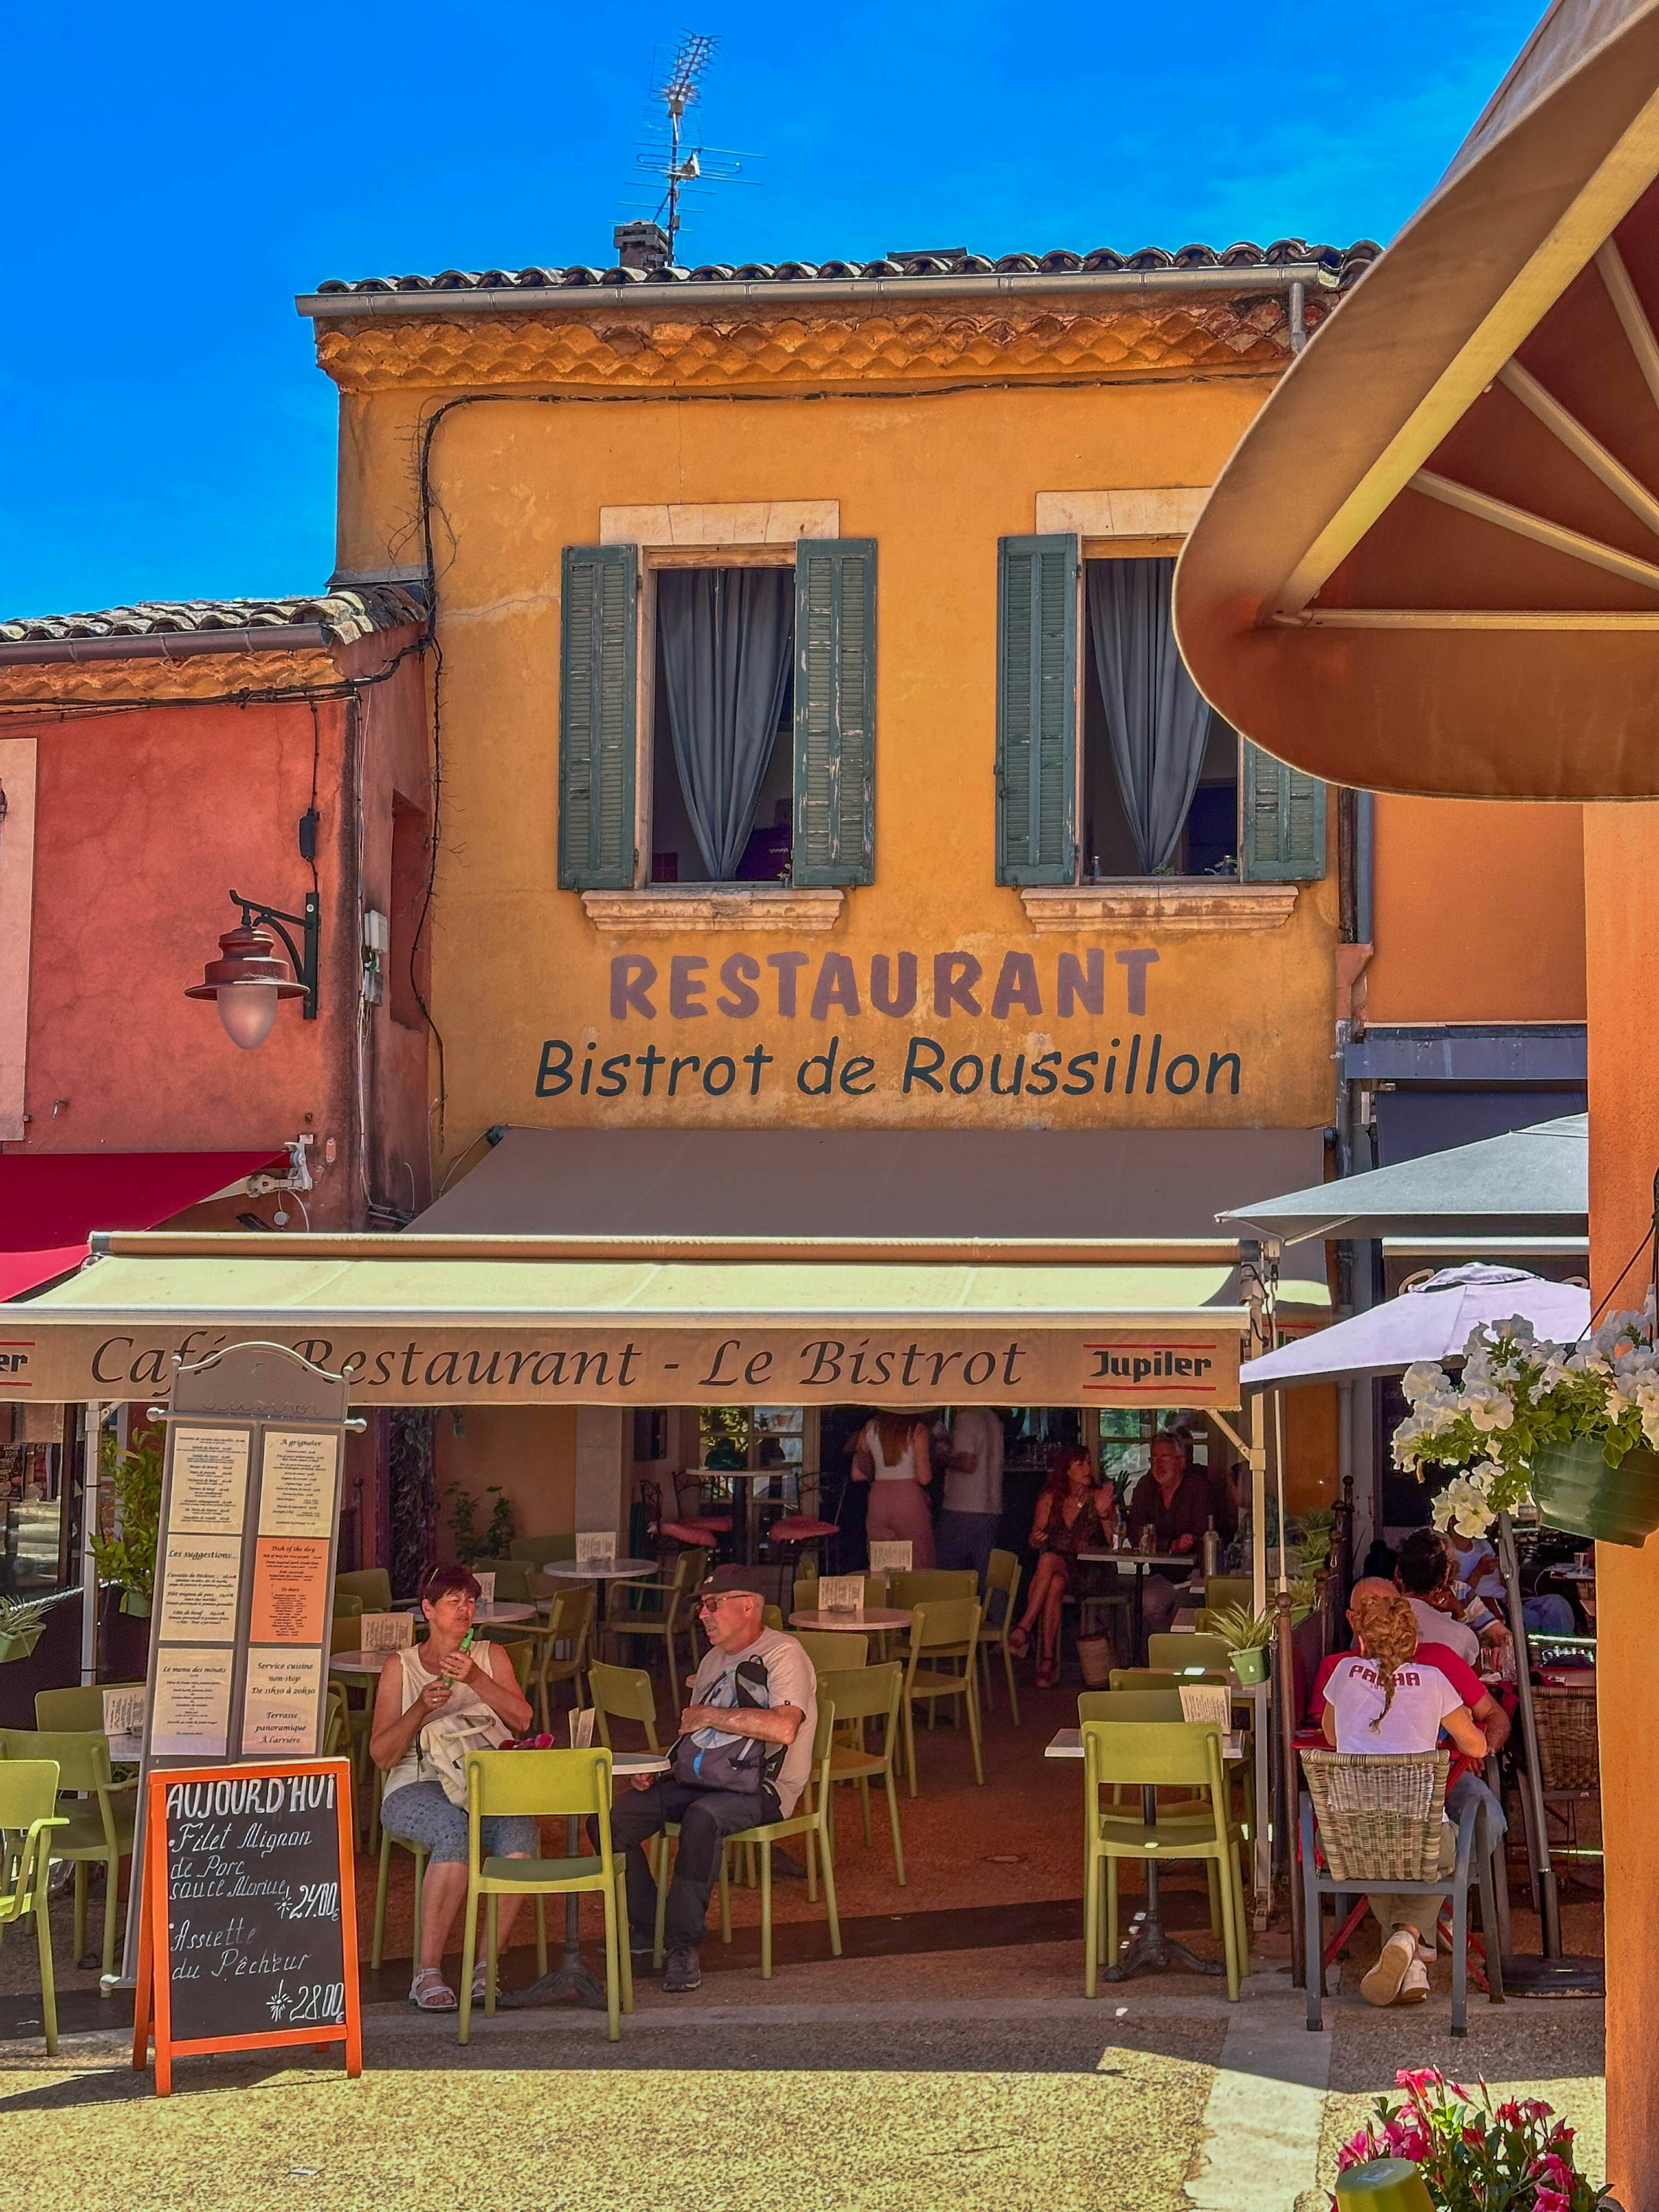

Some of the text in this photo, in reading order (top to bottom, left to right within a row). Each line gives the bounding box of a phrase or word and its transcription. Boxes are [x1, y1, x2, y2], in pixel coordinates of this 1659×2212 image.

[609, 948, 1160, 1021] RESTAURANT
[535, 1034, 1242, 1098] Bistrot de Roussillon
[291, 1338, 642, 1387] Restaurant
[697, 1340, 773, 1385] Le
[799, 1338, 1026, 1385] Bistrot
[1090, 1351, 1211, 1383] Jupiler
[254, 1724, 307, 1733] panoramique
[171, 1822, 232, 1853] Filet
[171, 1856, 245, 1880] de Porc
[170, 1879, 225, 1900] sauce
[171, 1917, 257, 1951] Assiette
[172, 1948, 312, 1980] du Pêcheur
